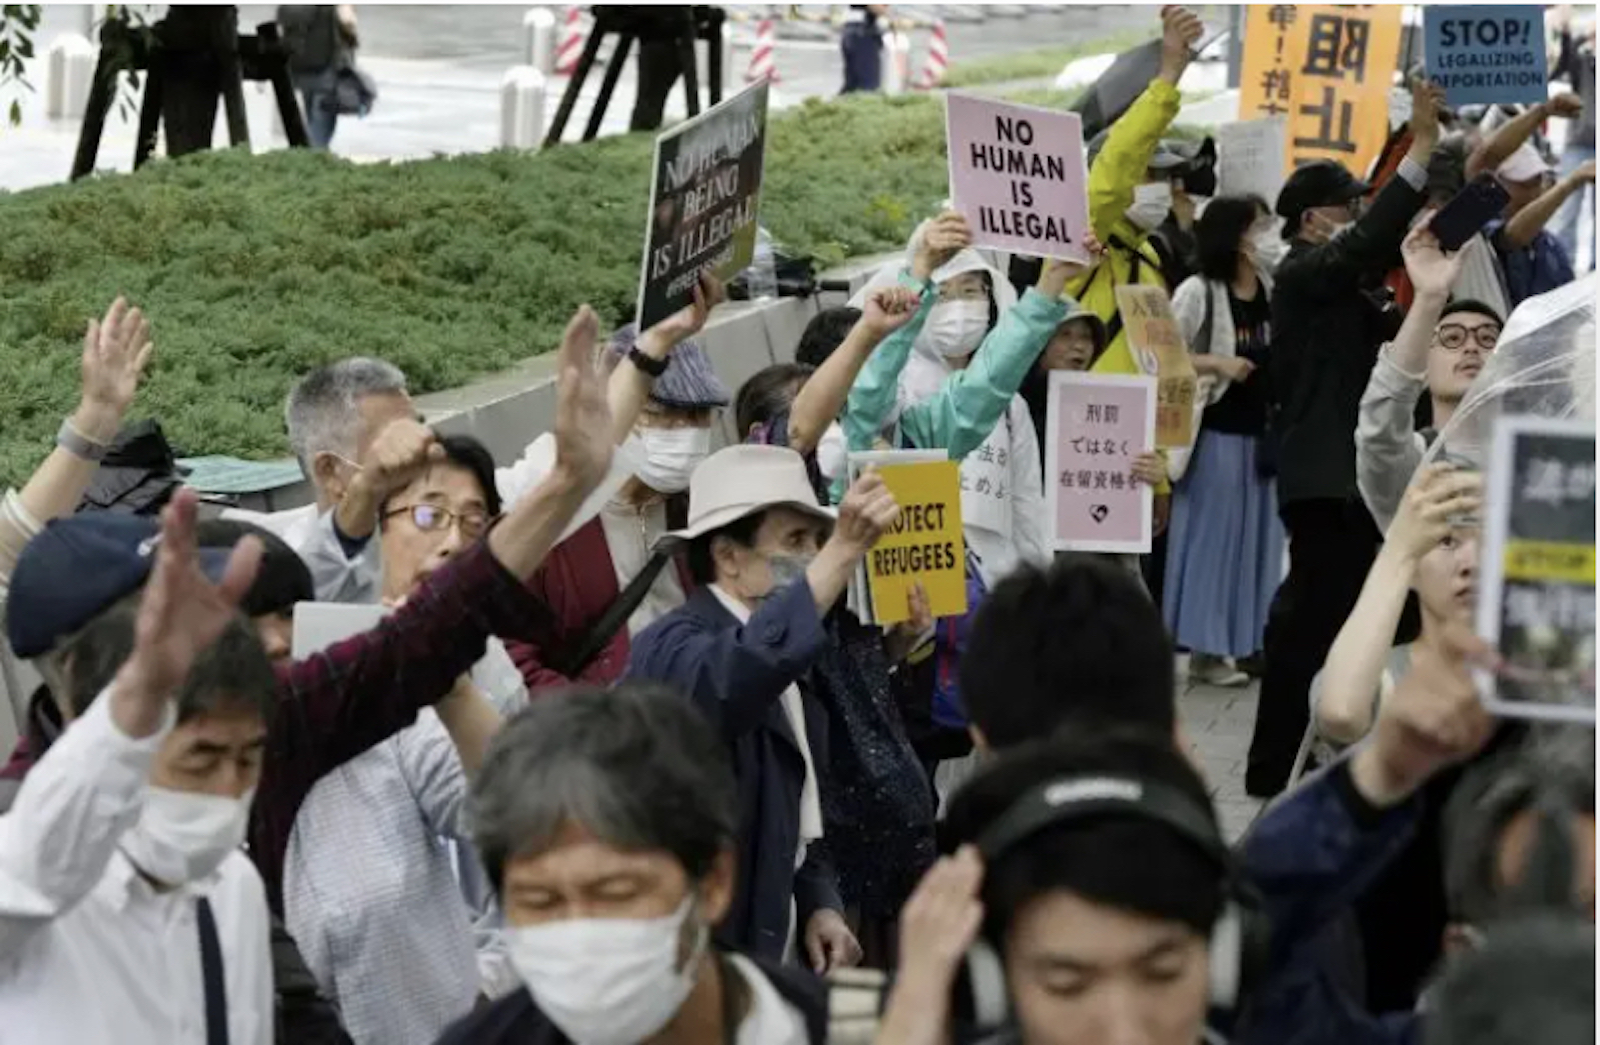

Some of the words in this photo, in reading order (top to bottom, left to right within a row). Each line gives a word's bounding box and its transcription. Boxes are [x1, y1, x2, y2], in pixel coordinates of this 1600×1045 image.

[1440, 19, 1531, 46] STOP!
[1438, 52, 1534, 68] LEGALIZING
[996, 115, 1034, 145] NO
[664, 152, 693, 192] NO
[970, 143, 1065, 182] HUMAN
[683, 165, 740, 221] BEING
[1011, 181, 1034, 207] IS
[651, 243, 672, 281] IS
[677, 196, 756, 267] ILLEGAL
[979, 205, 1072, 244] ILLEGAL
[1085, 404, 1120, 424] 刑罰
[1069, 436, 1130, 455] ではなく
[1060, 470, 1139, 490] 在留資格を
[884, 503, 945, 535] OTECT
[873, 542, 956, 577] REFUGEES
